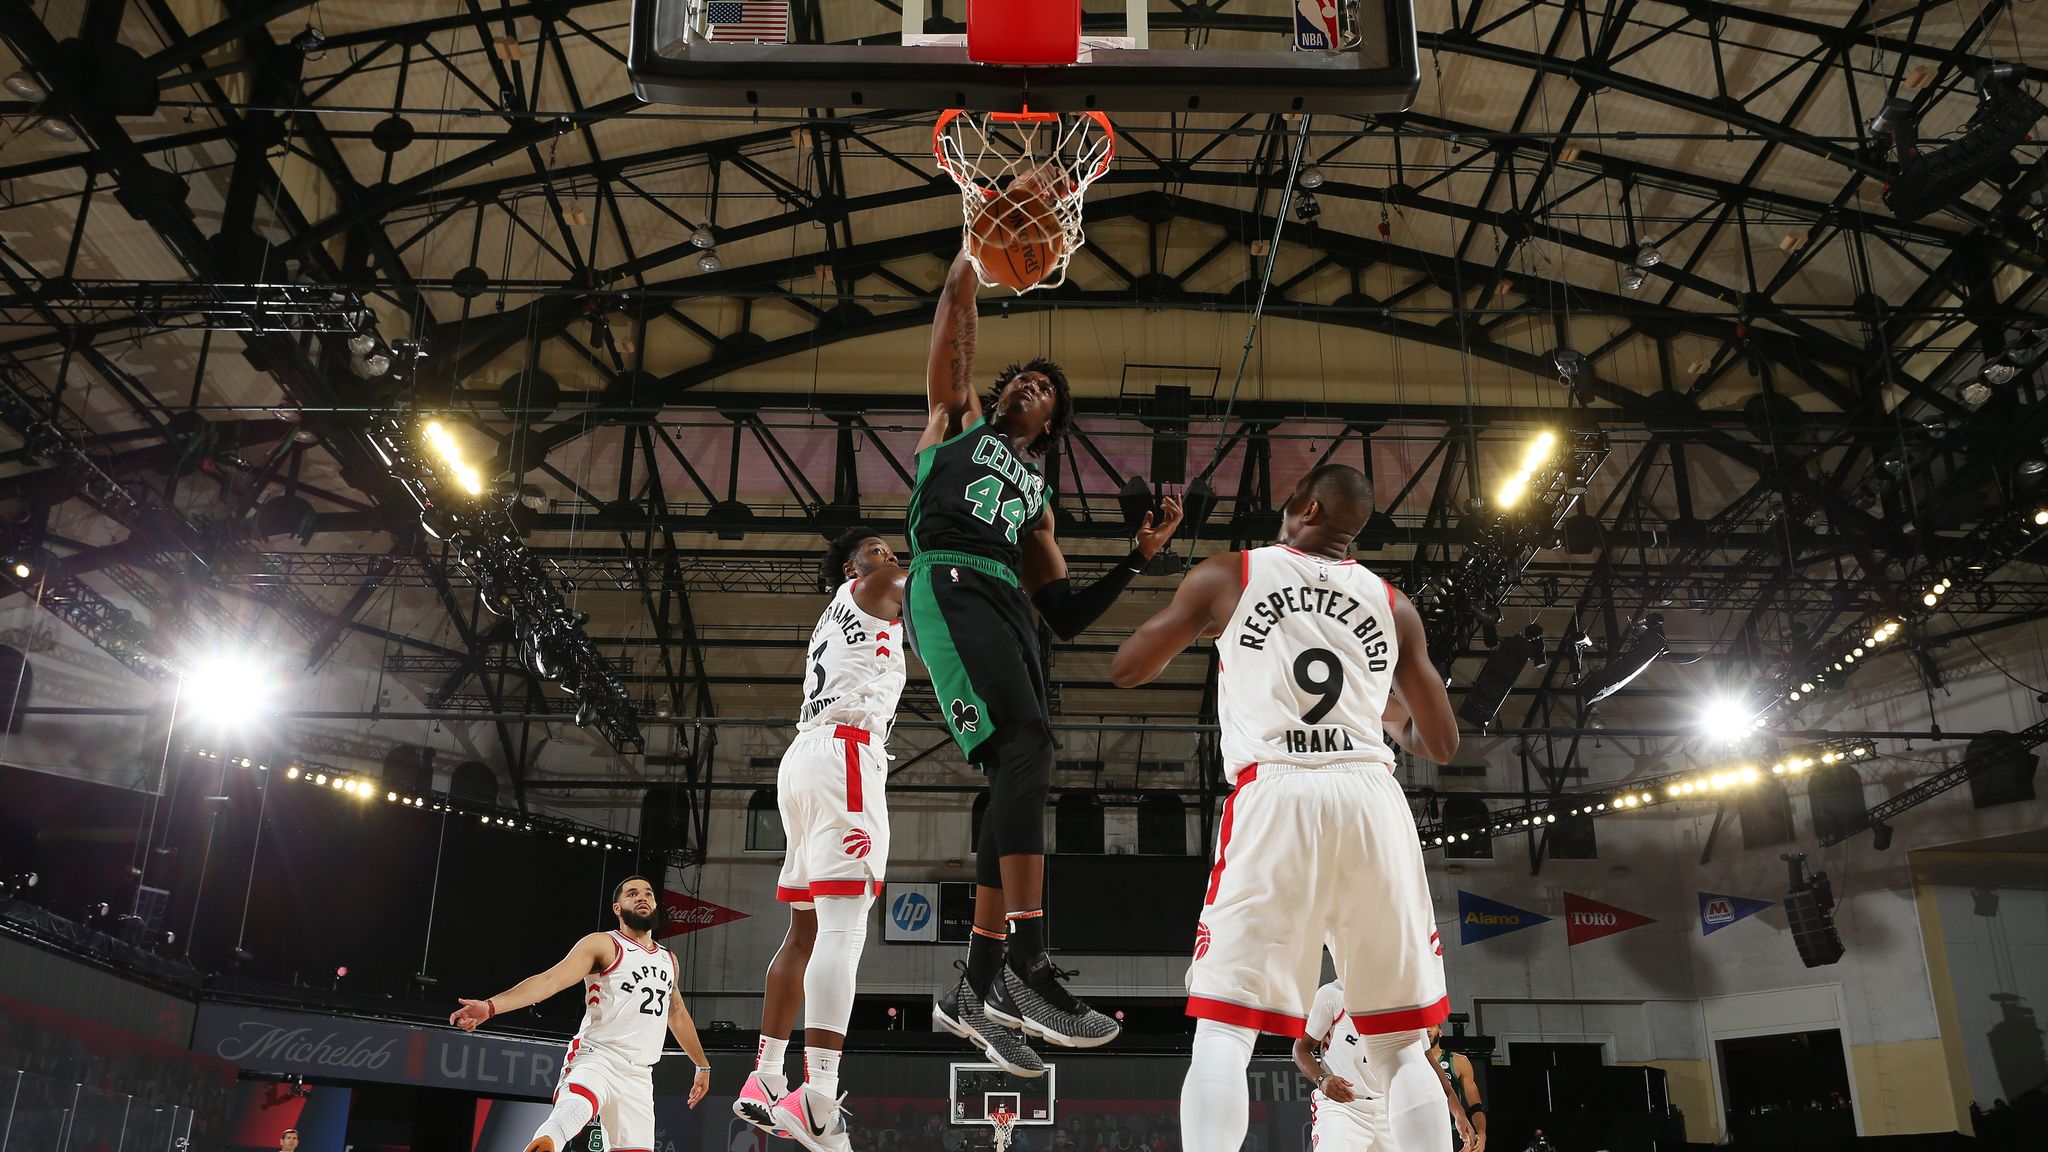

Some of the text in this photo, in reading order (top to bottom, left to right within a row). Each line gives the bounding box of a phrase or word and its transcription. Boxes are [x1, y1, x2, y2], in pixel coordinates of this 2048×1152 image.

[1302, 33, 1323, 46] NBA
[972, 435, 1043, 519] CELTICS
[965, 474, 1025, 545] 44
[1239, 586, 1388, 673] RESPECTEZ BISO
[1293, 648, 1344, 726] 9
[1285, 727, 1354, 754] IBAKA
[897, 893, 928, 931] hp
[1464, 911, 1519, 926] Alamo
[1572, 912, 1616, 926] TORO
[1709, 902, 1728, 915] M
[620, 965, 673, 1000] RAPTOR
[640, 987, 667, 1017] 23
[217, 1022, 554, 1088] Michelob ULTR
[1249, 1071, 1311, 1101] THE
[588, 1129, 604, 1151] 8
